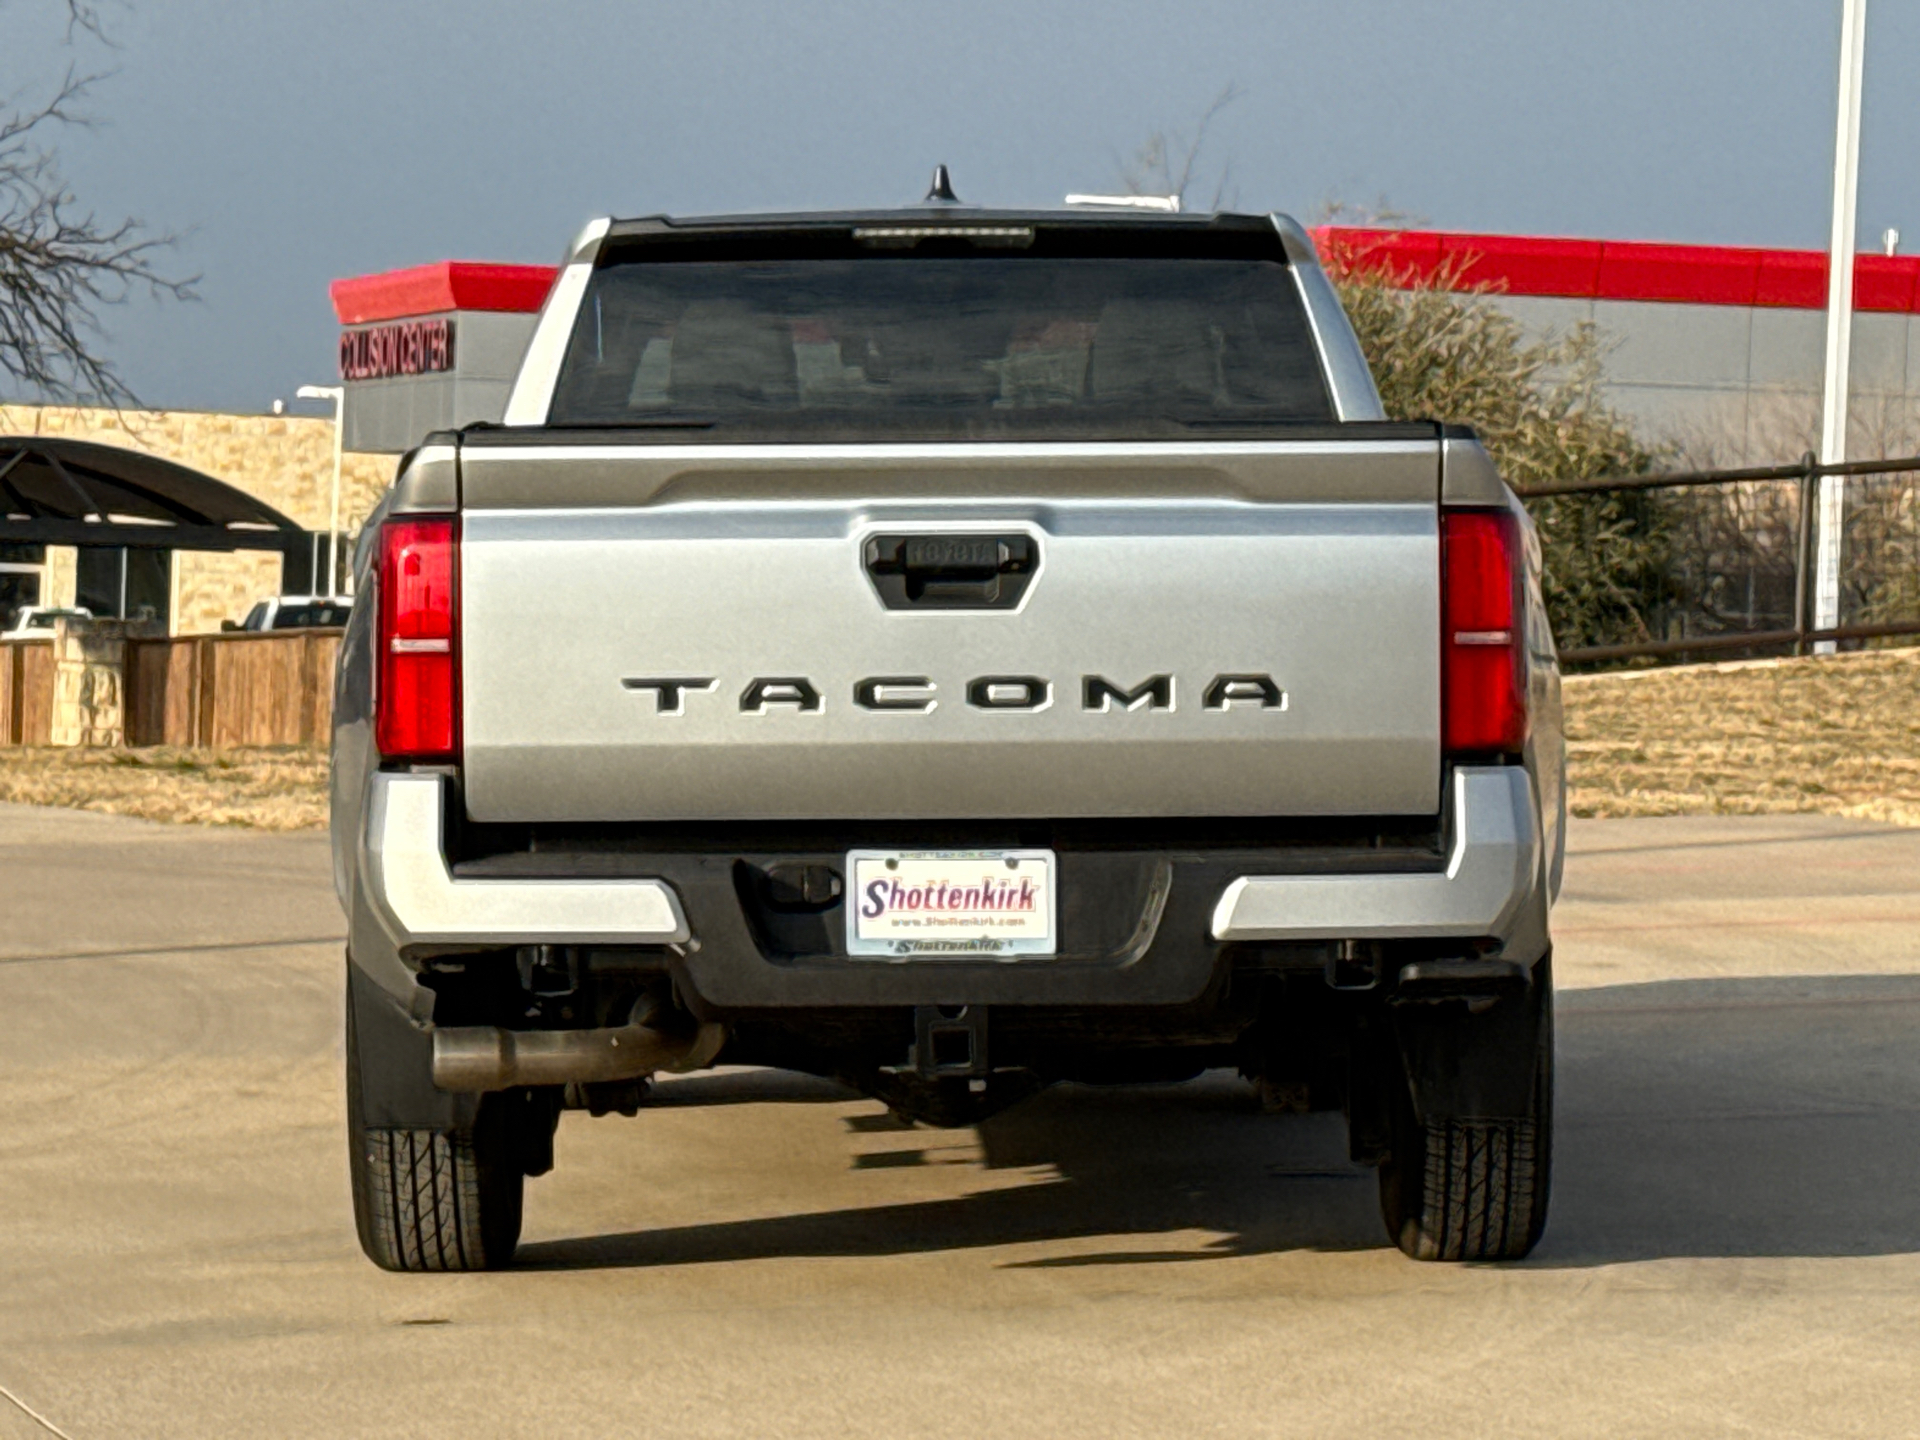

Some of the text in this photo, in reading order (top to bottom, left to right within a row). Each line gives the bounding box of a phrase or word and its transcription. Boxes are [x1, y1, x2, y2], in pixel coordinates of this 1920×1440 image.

[338, 319, 453, 380] COLLISION CENTER
[910, 540, 991, 563] TOYOTA
[620, 673, 1290, 717] TACOMA
[861, 877, 1037, 919] Shottenkirk
